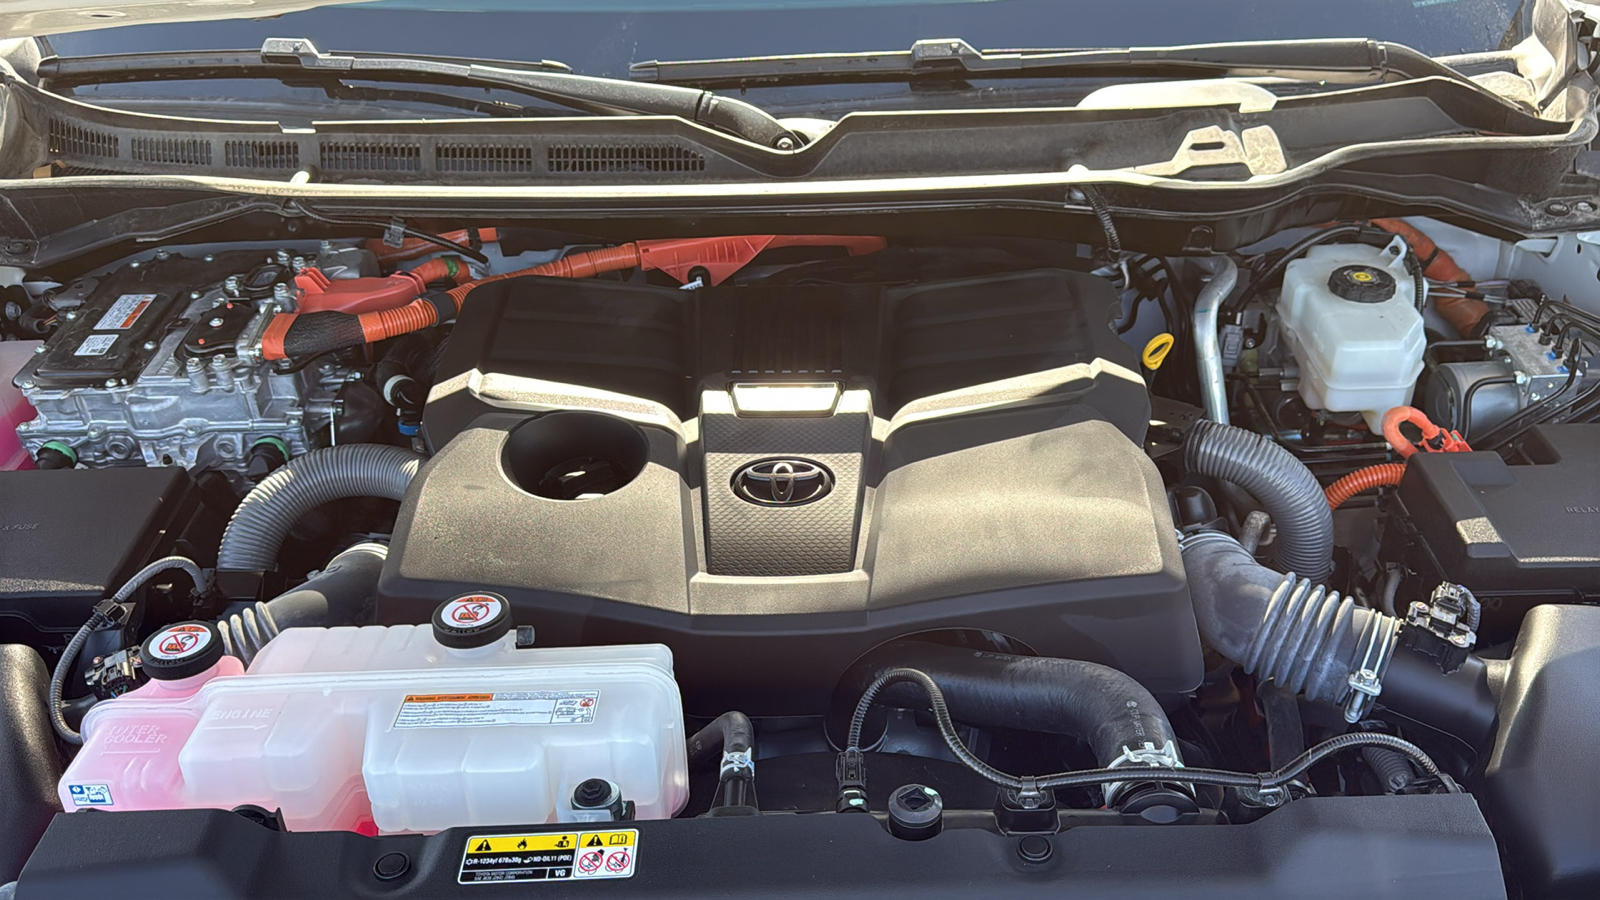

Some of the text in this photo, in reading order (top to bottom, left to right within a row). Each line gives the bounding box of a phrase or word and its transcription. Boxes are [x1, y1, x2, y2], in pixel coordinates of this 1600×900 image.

[212, 708, 273, 720] ENGINE
[109, 724, 160, 735] INTER
[103, 733, 168, 744] COOLER
[473, 857, 498, 865] R-1234yf
[557, 854, 573, 863] (POE)
[555, 869, 566, 877] VG
